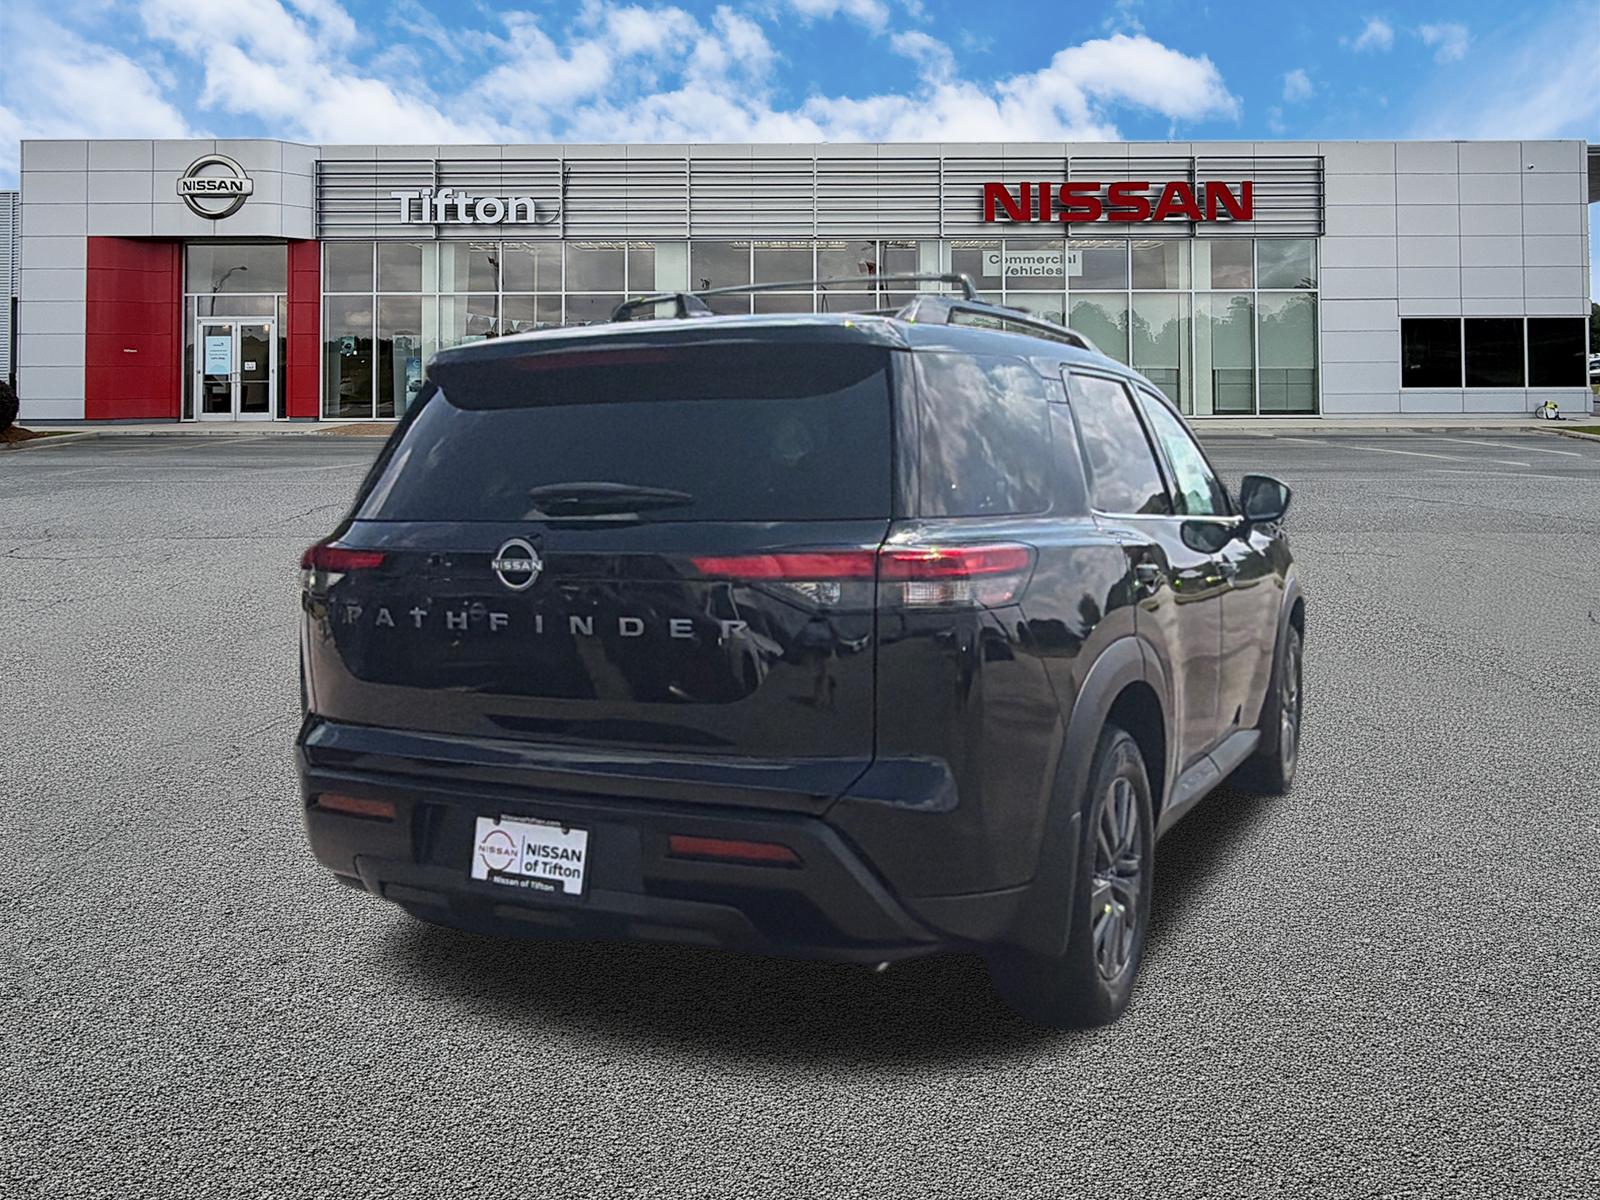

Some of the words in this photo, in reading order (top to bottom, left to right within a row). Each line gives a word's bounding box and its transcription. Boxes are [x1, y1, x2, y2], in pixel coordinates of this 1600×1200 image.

[183, 180, 243, 191] NISSAN
[391, 188, 536, 224] Tifton
[983, 181, 1254, 222] NISSAN
[491, 560, 543, 571] NISSAN
[342, 605, 749, 640] PATHFINDER
[478, 844, 518, 857] NISSAN
[526, 843, 582, 862] NISSAN
[524, 860, 539, 872] of
[541, 861, 581, 879] Tifton
